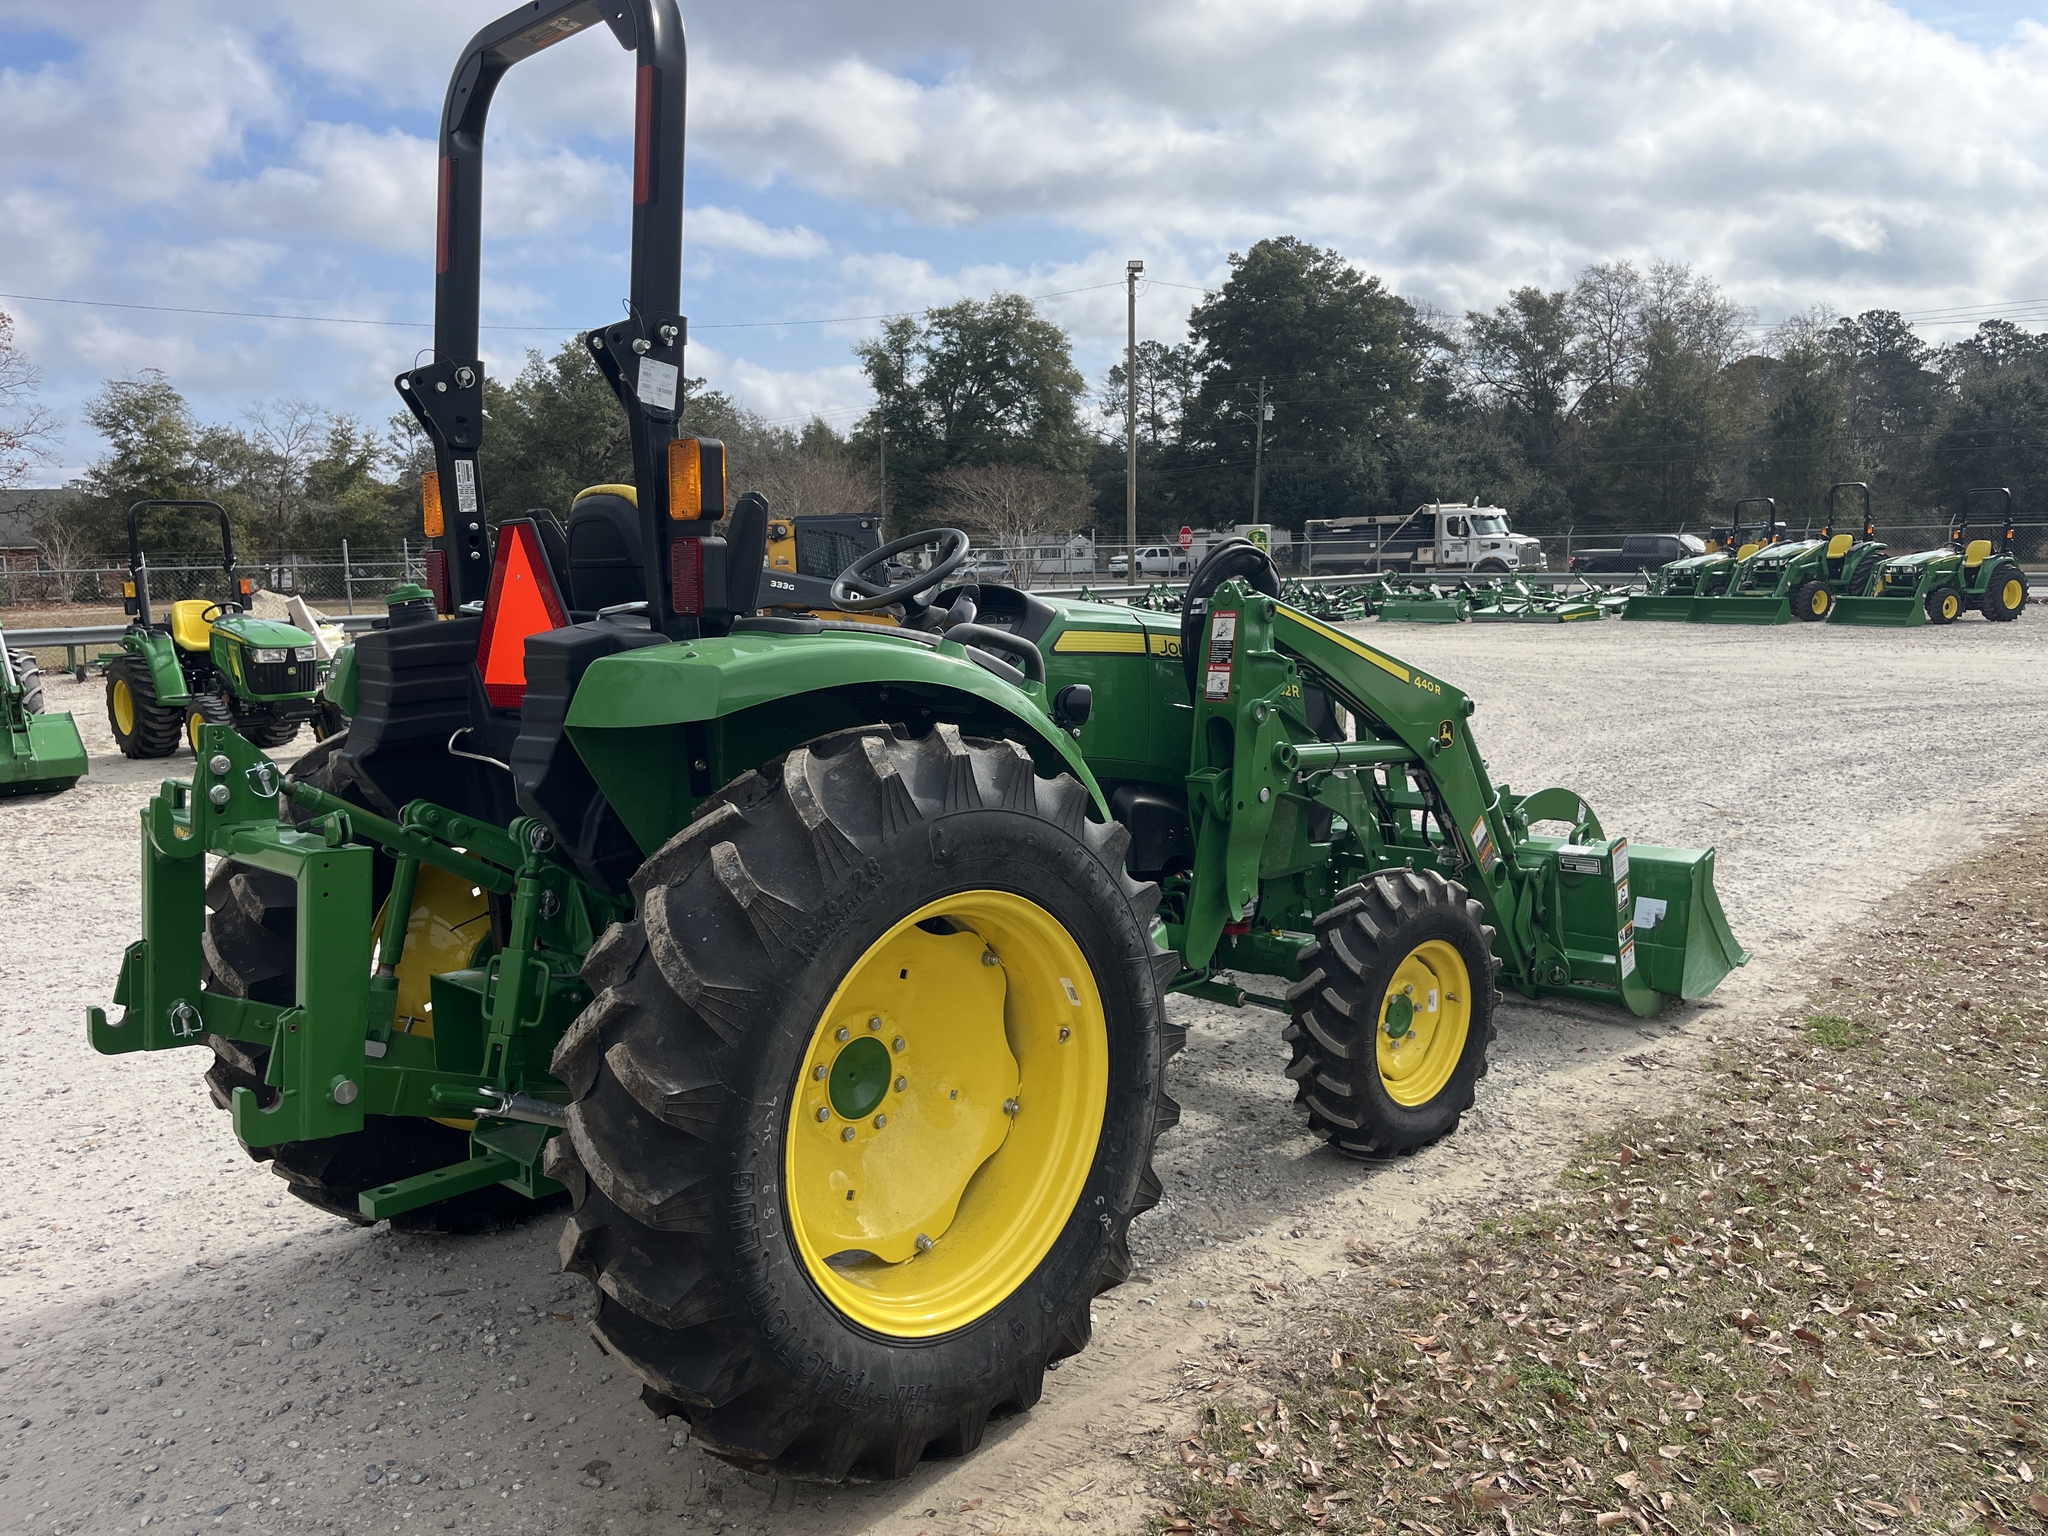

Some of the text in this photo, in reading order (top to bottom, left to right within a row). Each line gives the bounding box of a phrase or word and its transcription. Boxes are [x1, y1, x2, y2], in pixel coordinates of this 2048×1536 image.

[1180, 534, 1192, 543] STOP
[770, 580, 795, 591] 333G
[728, 1170, 762, 1256] LUG
